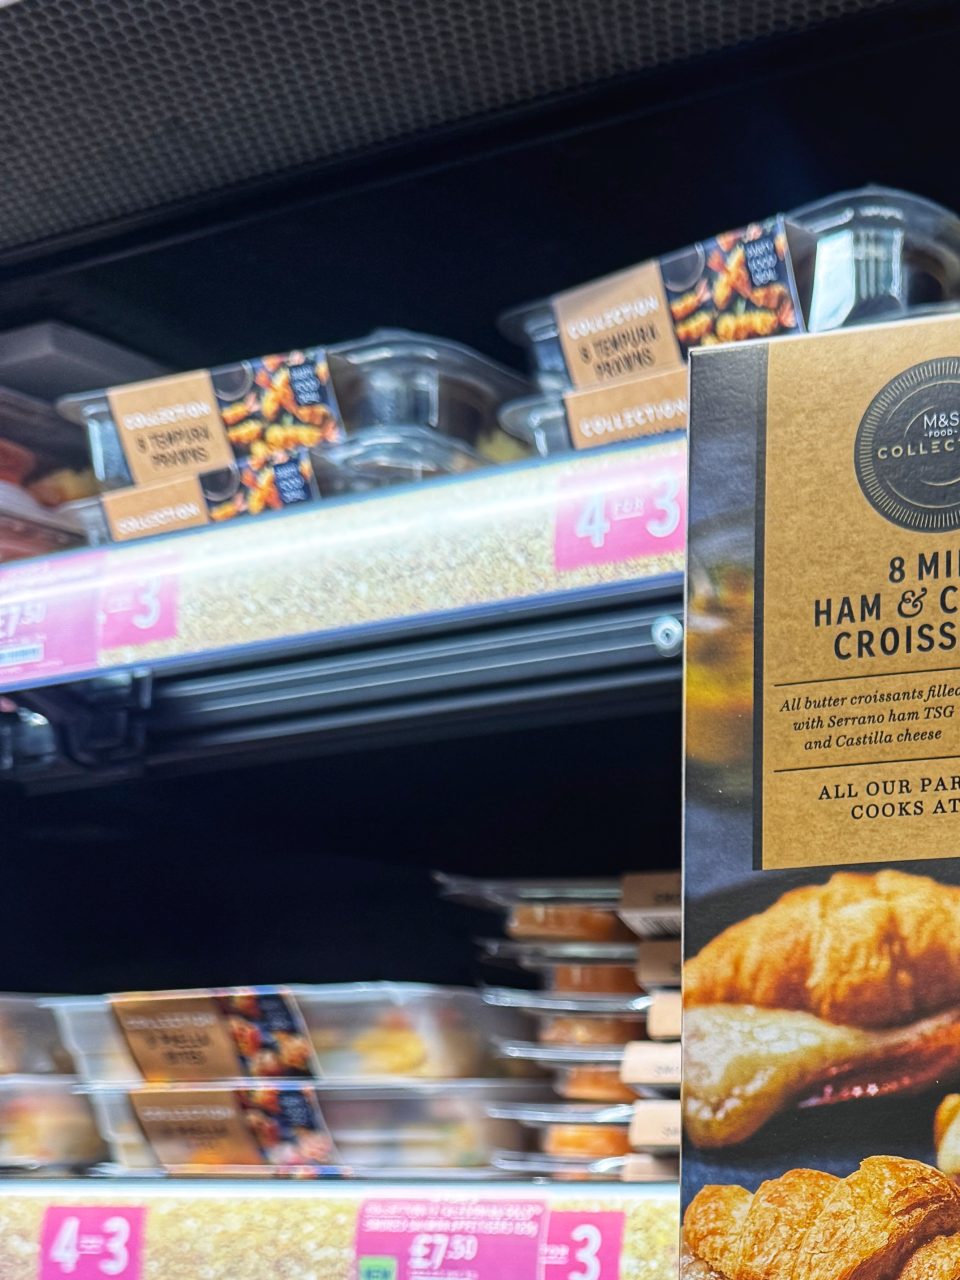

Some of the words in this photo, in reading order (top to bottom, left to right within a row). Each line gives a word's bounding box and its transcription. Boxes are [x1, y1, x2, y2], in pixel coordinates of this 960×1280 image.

[923, 411, 960, 430] M&S
[575, 492, 611, 548] 4
[645, 469, 680, 538] 3
[888, 556, 906, 584] 8
[814, 593, 881, 628] HAM
[897, 587, 928, 618] &
[779, 698, 802, 712] All
[804, 695, 848, 711] butter
[850, 688, 924, 706] croissants
[793, 716, 824, 731] with
[827, 713, 885, 729] Serrano
[888, 709, 920, 723] ham
[923, 705, 956, 720] TSG
[804, 735, 832, 751] and
[835, 730, 893, 748] Castilla
[896, 728, 942, 742] cheese
[818, 783, 859, 800] ALL
[866, 779, 912, 797] OUR
[851, 801, 924, 820] COOKS
[50, 1216, 80, 1274] 4
[98, 1216, 131, 1275] 3
